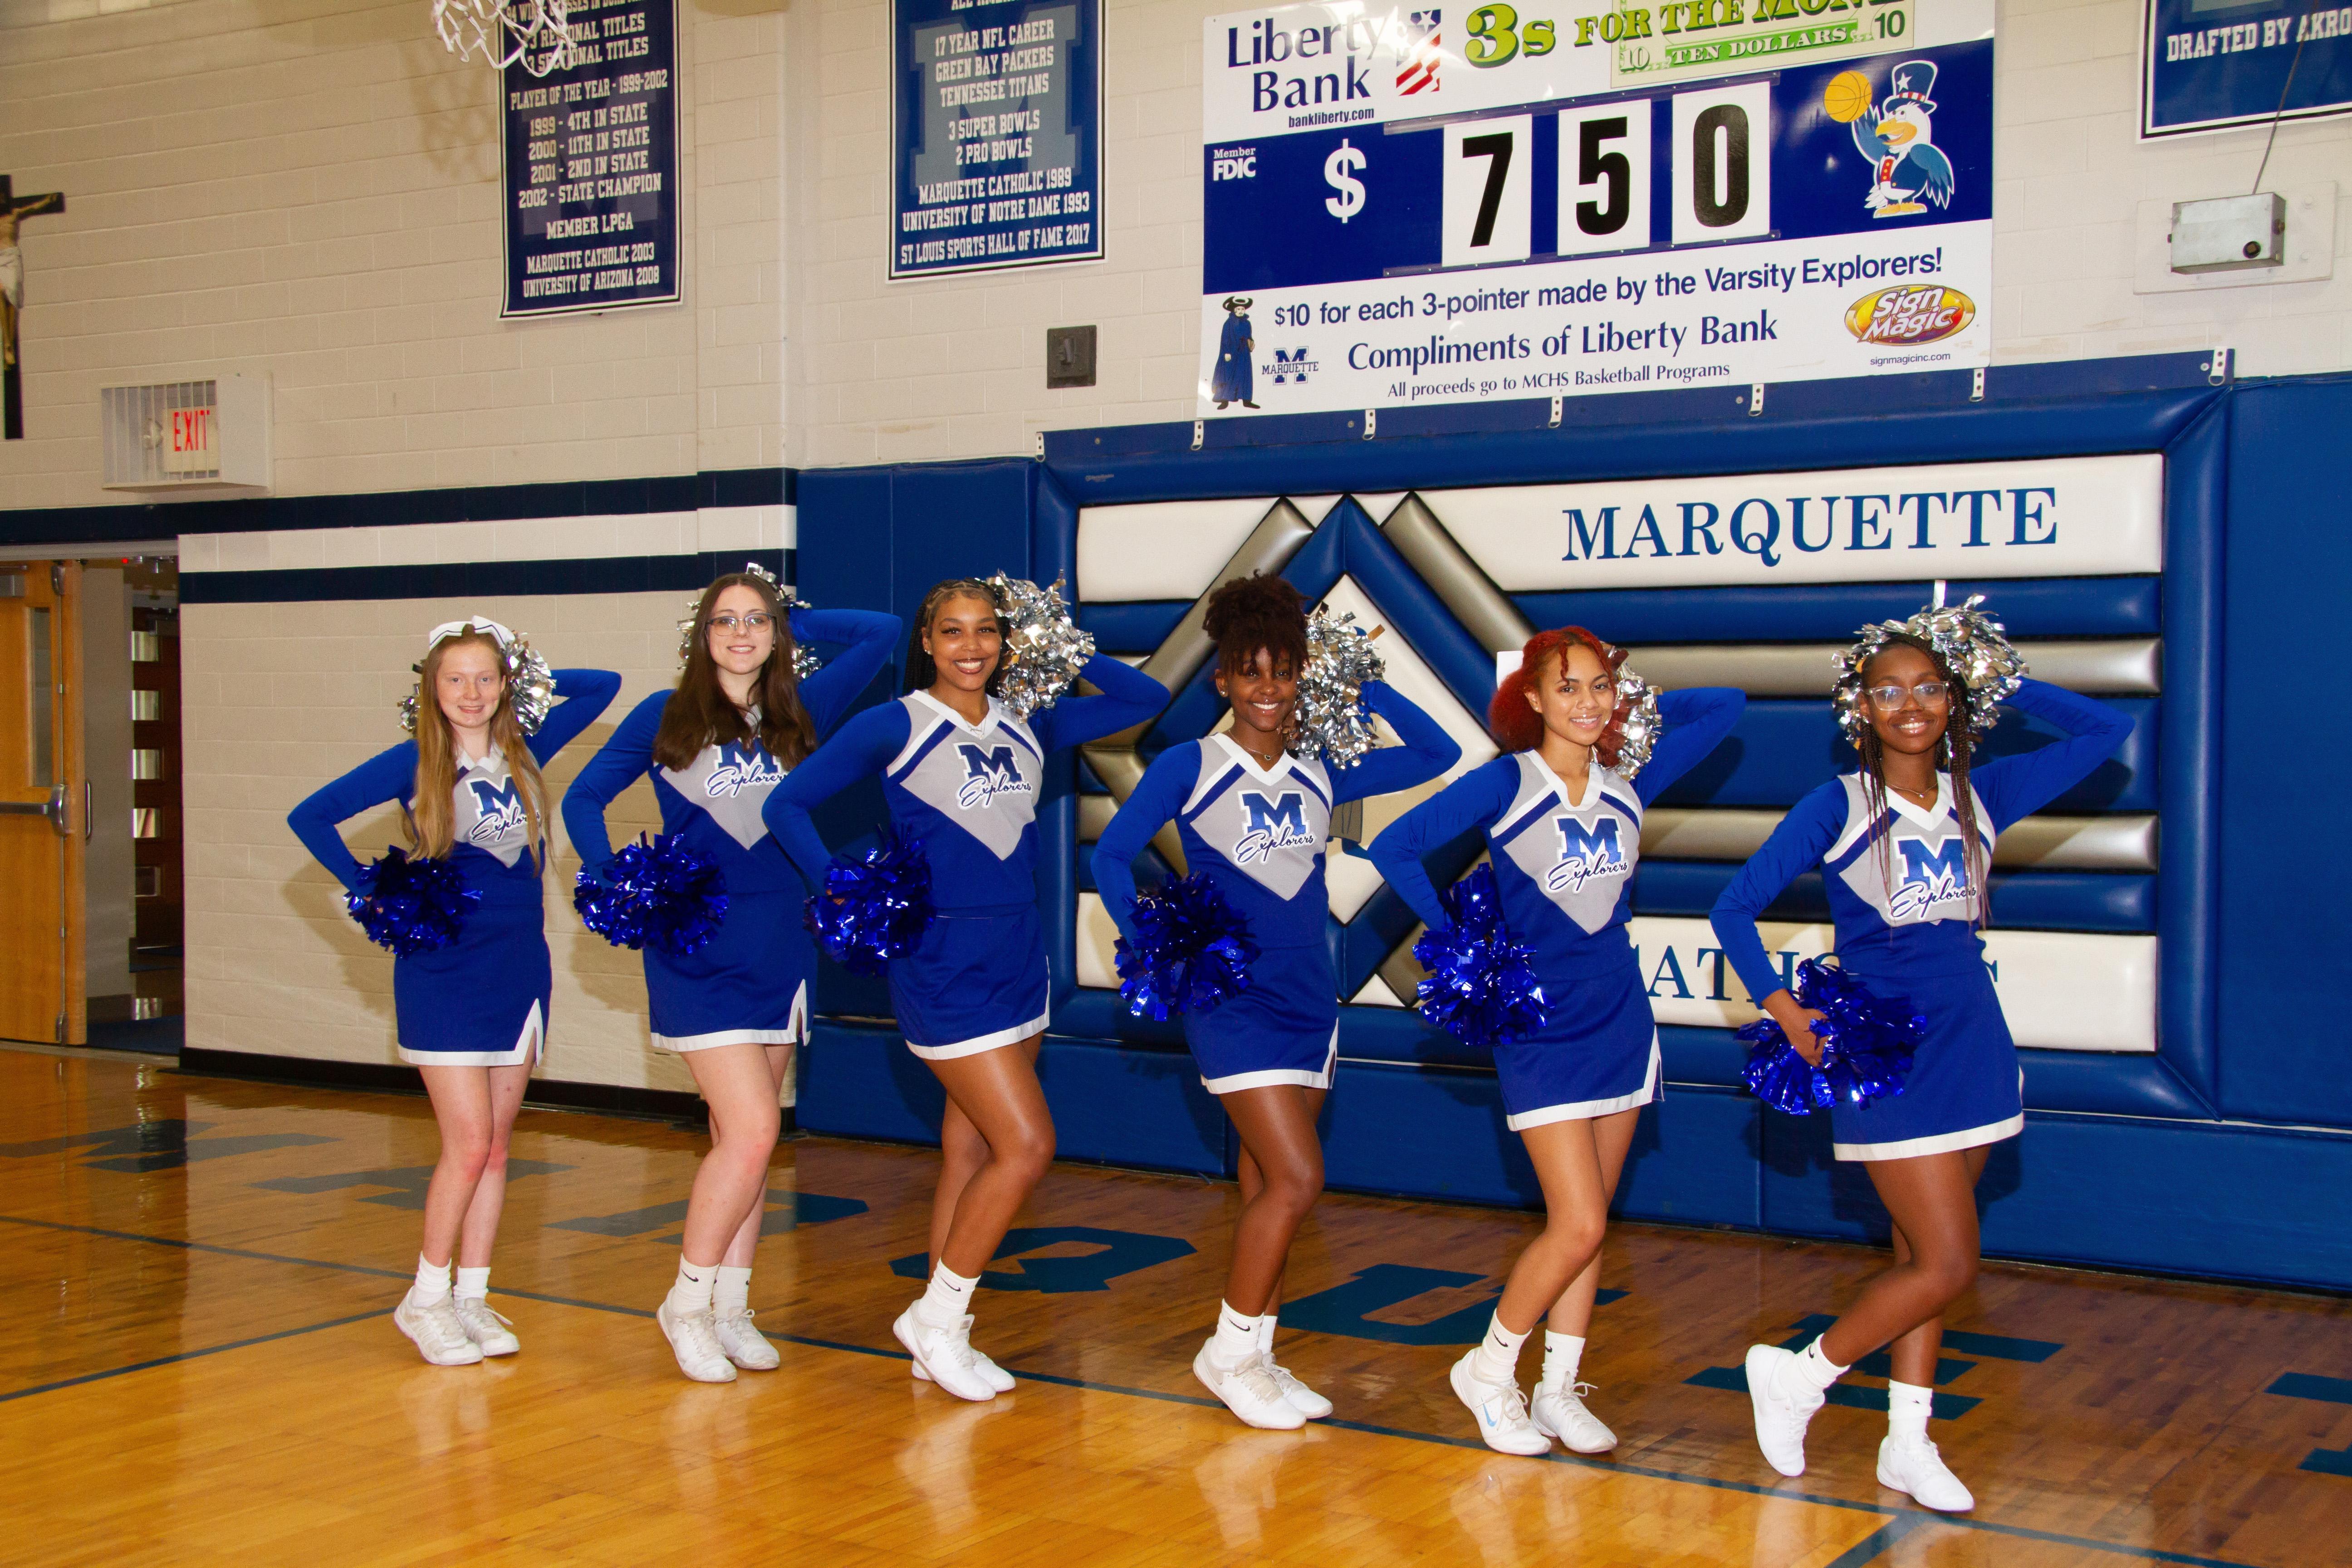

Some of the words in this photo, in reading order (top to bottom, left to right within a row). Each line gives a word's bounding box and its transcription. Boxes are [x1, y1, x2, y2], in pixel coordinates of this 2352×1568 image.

[540, 21, 600, 48] REONAL
[602, 12, 645, 37] TITLES
[935, 37, 946, 57] 17
[949, 30, 979, 54] YEAR
[982, 28, 1006, 49] NFL
[1009, 19, 1055, 45] CAREER
[1228, 16, 1387, 68] Liberty
[1465, 3, 1557, 69] 3s
[1574, 2, 1652, 47] FOR
[1661, 0, 1744, 30] THE
[1874, 10, 1906, 39] 10
[2166, 23, 2257, 62] DRAFTED
[2263, 17, 2292, 48] BY
[2296, 7, 2352, 43] AKRO
[538, 45, 603, 72] SETONAL
[606, 36, 649, 60] TITLES
[936, 59, 972, 83] GREEN
[975, 55, 999, 76] BAY
[1001, 45, 1054, 72] PACKERS
[1620, 46, 1650, 72] 10
[1672, 46, 1720, 64] TEN
[1728, 27, 1847, 58] DOLLARS
[510, 90, 547, 110] PLAYER
[549, 86, 561, 105] OF
[563, 83, 583, 103] THE
[584, 78, 610, 99] YEAR
[619, 69, 668, 94] 1999-2002
[940, 81, 1006, 107] TENNESSEE
[1009, 73, 1049, 98] TITANS
[1253, 55, 1371, 113] Bank
[530, 116, 556, 137] 1999
[568, 111, 591, 131] 4TH
[594, 108, 607, 127] IN
[610, 102, 648, 125] STATE
[949, 121, 956, 141] 3
[958, 116, 996, 140] SUPER
[999, 110, 1040, 134] BOWLS
[1289, 108, 1375, 128] bankliberty.com
[529, 139, 557, 161] 2000
[568, 134, 593, 155] 11TH
[596, 132, 609, 151] IN
[612, 126, 650, 149] STATE
[956, 146, 963, 165] 2
[966, 143, 989, 164] PRO
[991, 137, 1032, 161] BOWLS
[1214, 147, 1256, 159] Member
[530, 163, 556, 184] 2001
[568, 158, 591, 179] 2ND
[594, 156, 608, 175] IN
[611, 150, 648, 173] STATE
[1213, 157, 1256, 181] FDIC
[519, 188, 547, 209] 2002
[559, 181, 594, 204] STATE
[598, 173, 662, 199] CHAMPION
[918, 178, 986, 205] MARQUETTE
[988, 171, 1044, 197] CATHOLIC
[1046, 167, 1072, 189] 1989
[546, 216, 598, 240] MEMBER
[602, 212, 633, 234] LPGA
[902, 205, 969, 232] UNIVERSITY
[971, 203, 986, 224] OF
[989, 199, 1025, 223] NOTRE
[1028, 195, 1061, 218] DAME
[1063, 191, 1089, 213] 1993
[527, 250, 583, 274] MARQUETTE
[585, 245, 629, 268] CATHOLIC
[631, 242, 654, 262] 2003
[901, 244, 914, 265] ST
[916, 241, 945, 263] LOUIS
[947, 237, 985, 260] SPORTS
[987, 233, 1015, 255] HALL
[1018, 230, 1031, 250] OF
[1033, 227, 1064, 250] FAME
[1066, 223, 1090, 245] 2017
[523, 275, 577, 298] UNIVERSITY
[580, 273, 593, 292] OF
[594, 269, 634, 290] ARIZONA
[636, 266, 660, 285] 2008
[1275, 304, 1310, 328] $10
[1320, 302, 1351, 323] for
[1358, 295, 1414, 321] each
[1422, 289, 1529, 320] 3-pointer
[1539, 279, 1607, 306] made
[1617, 276, 1646, 306] by
[1655, 270, 1696, 297] the
[1705, 262, 1796, 294] Varsity
[1802, 247, 1943, 289] Explorers!
[1871, 286, 1946, 318] Sign
[1348, 333, 1531, 376] Compliments
[1542, 324, 1572, 358] of
[1582, 320, 1688, 358] Liberty
[1701, 309, 1778, 345] Bank
[1857, 306, 1960, 343] Magic
[1262, 362, 1319, 375] MARQUETTE
[1870, 353, 1950, 367] signmagicinc.com
[1387, 381, 1406, 397] All
[1411, 378, 1475, 400] proceeds
[1480, 379, 1497, 395] go
[1503, 377, 1517, 390] to
[1522, 372, 1569, 388] MCHS
[1575, 365, 1651, 386] Basketball
[1656, 363, 1730, 383] Programs
[173, 410, 210, 451] EXIT
[1562, 487, 2058, 567] MARQUETTE
[953, 742, 1024, 783] M
[959, 773, 1031, 807] Explorers
[470, 806, 540, 841] Explor
[1238, 790, 1310, 836] M
[1235, 826, 1314, 862] Explorers
[1553, 814, 1625, 865] M
[1548, 853, 1628, 891] Explorers
[1893, 834, 1970, 889] M
